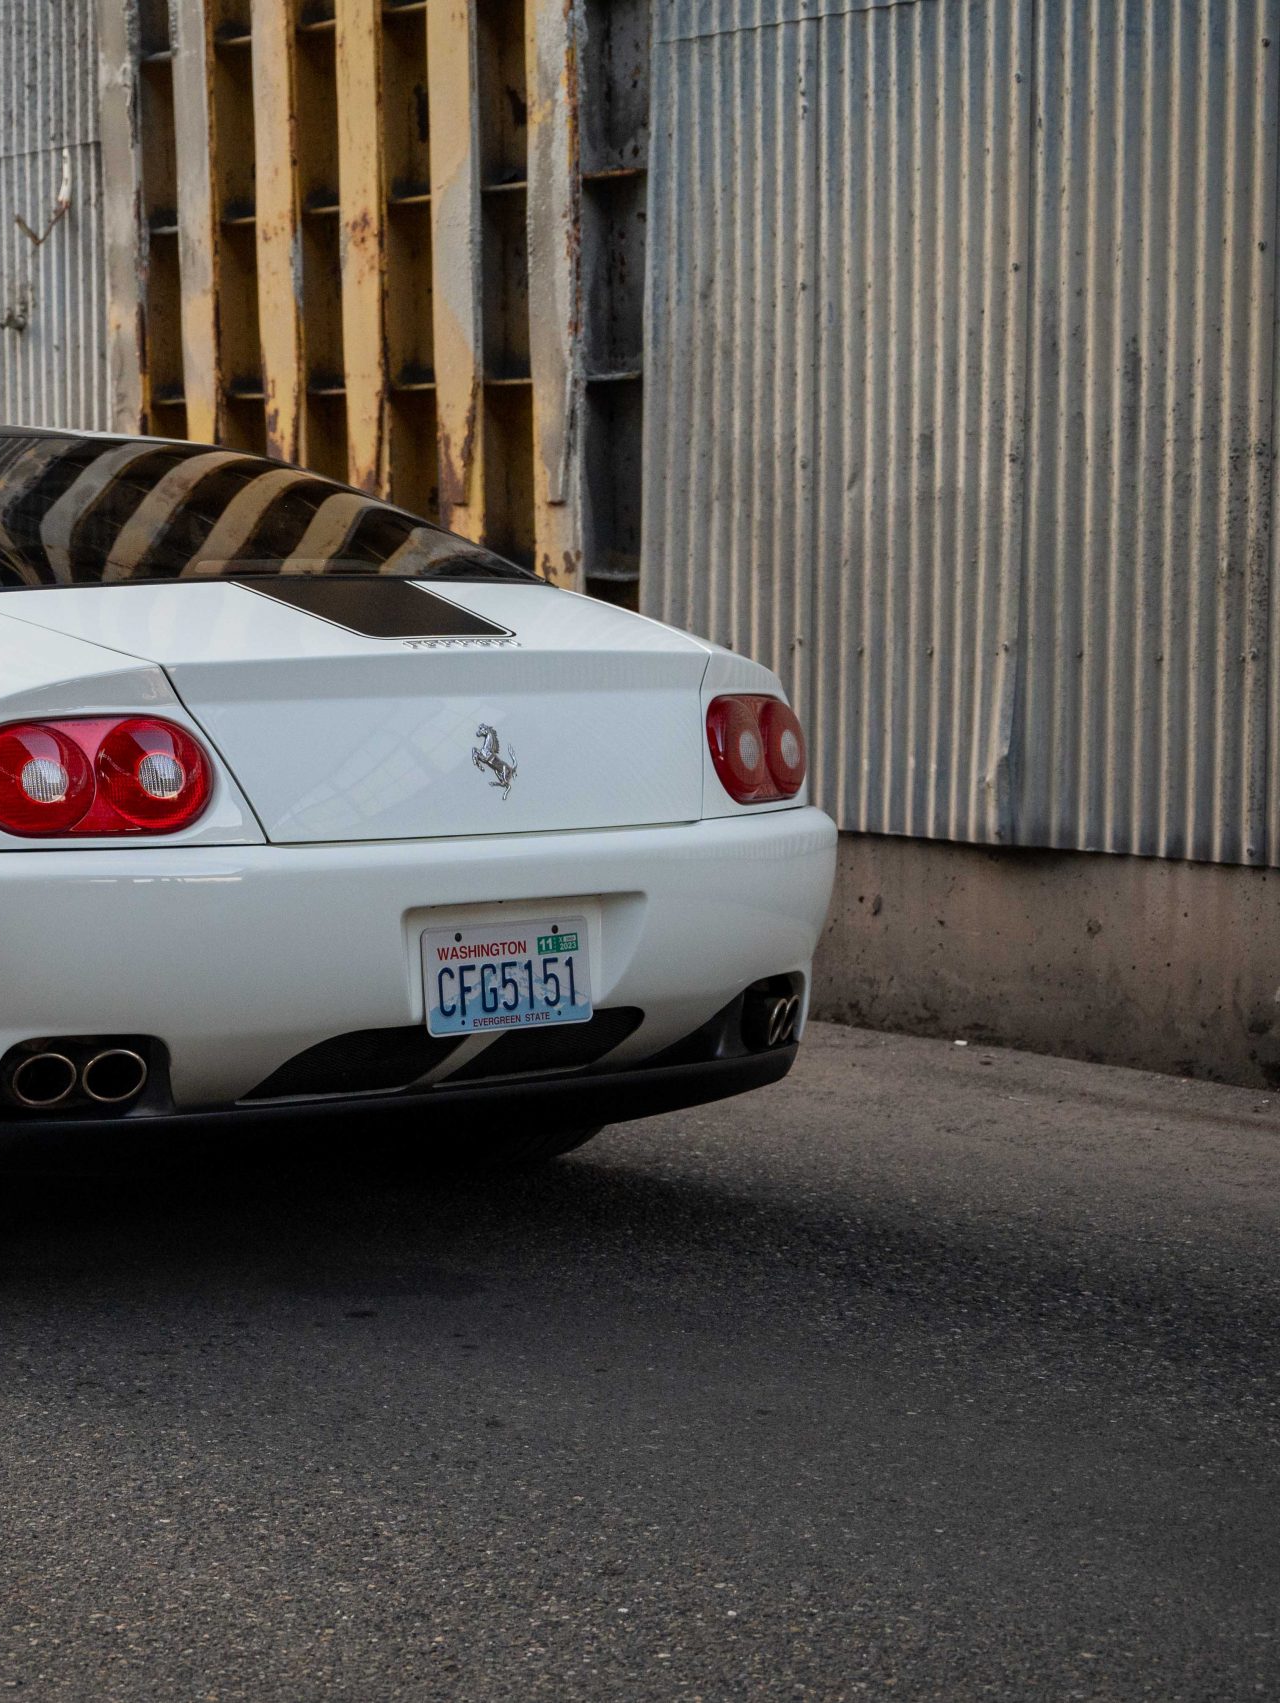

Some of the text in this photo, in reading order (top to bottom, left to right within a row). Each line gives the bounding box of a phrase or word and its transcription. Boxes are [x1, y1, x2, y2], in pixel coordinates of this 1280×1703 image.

[437, 940, 527, 961] WASHINGTON
[539, 937, 553, 951] 11
[559, 941, 577, 951] 2023
[438, 956, 576, 1017] CFG5151
[473, 1011, 551, 1027] EVERGREEN STATE
